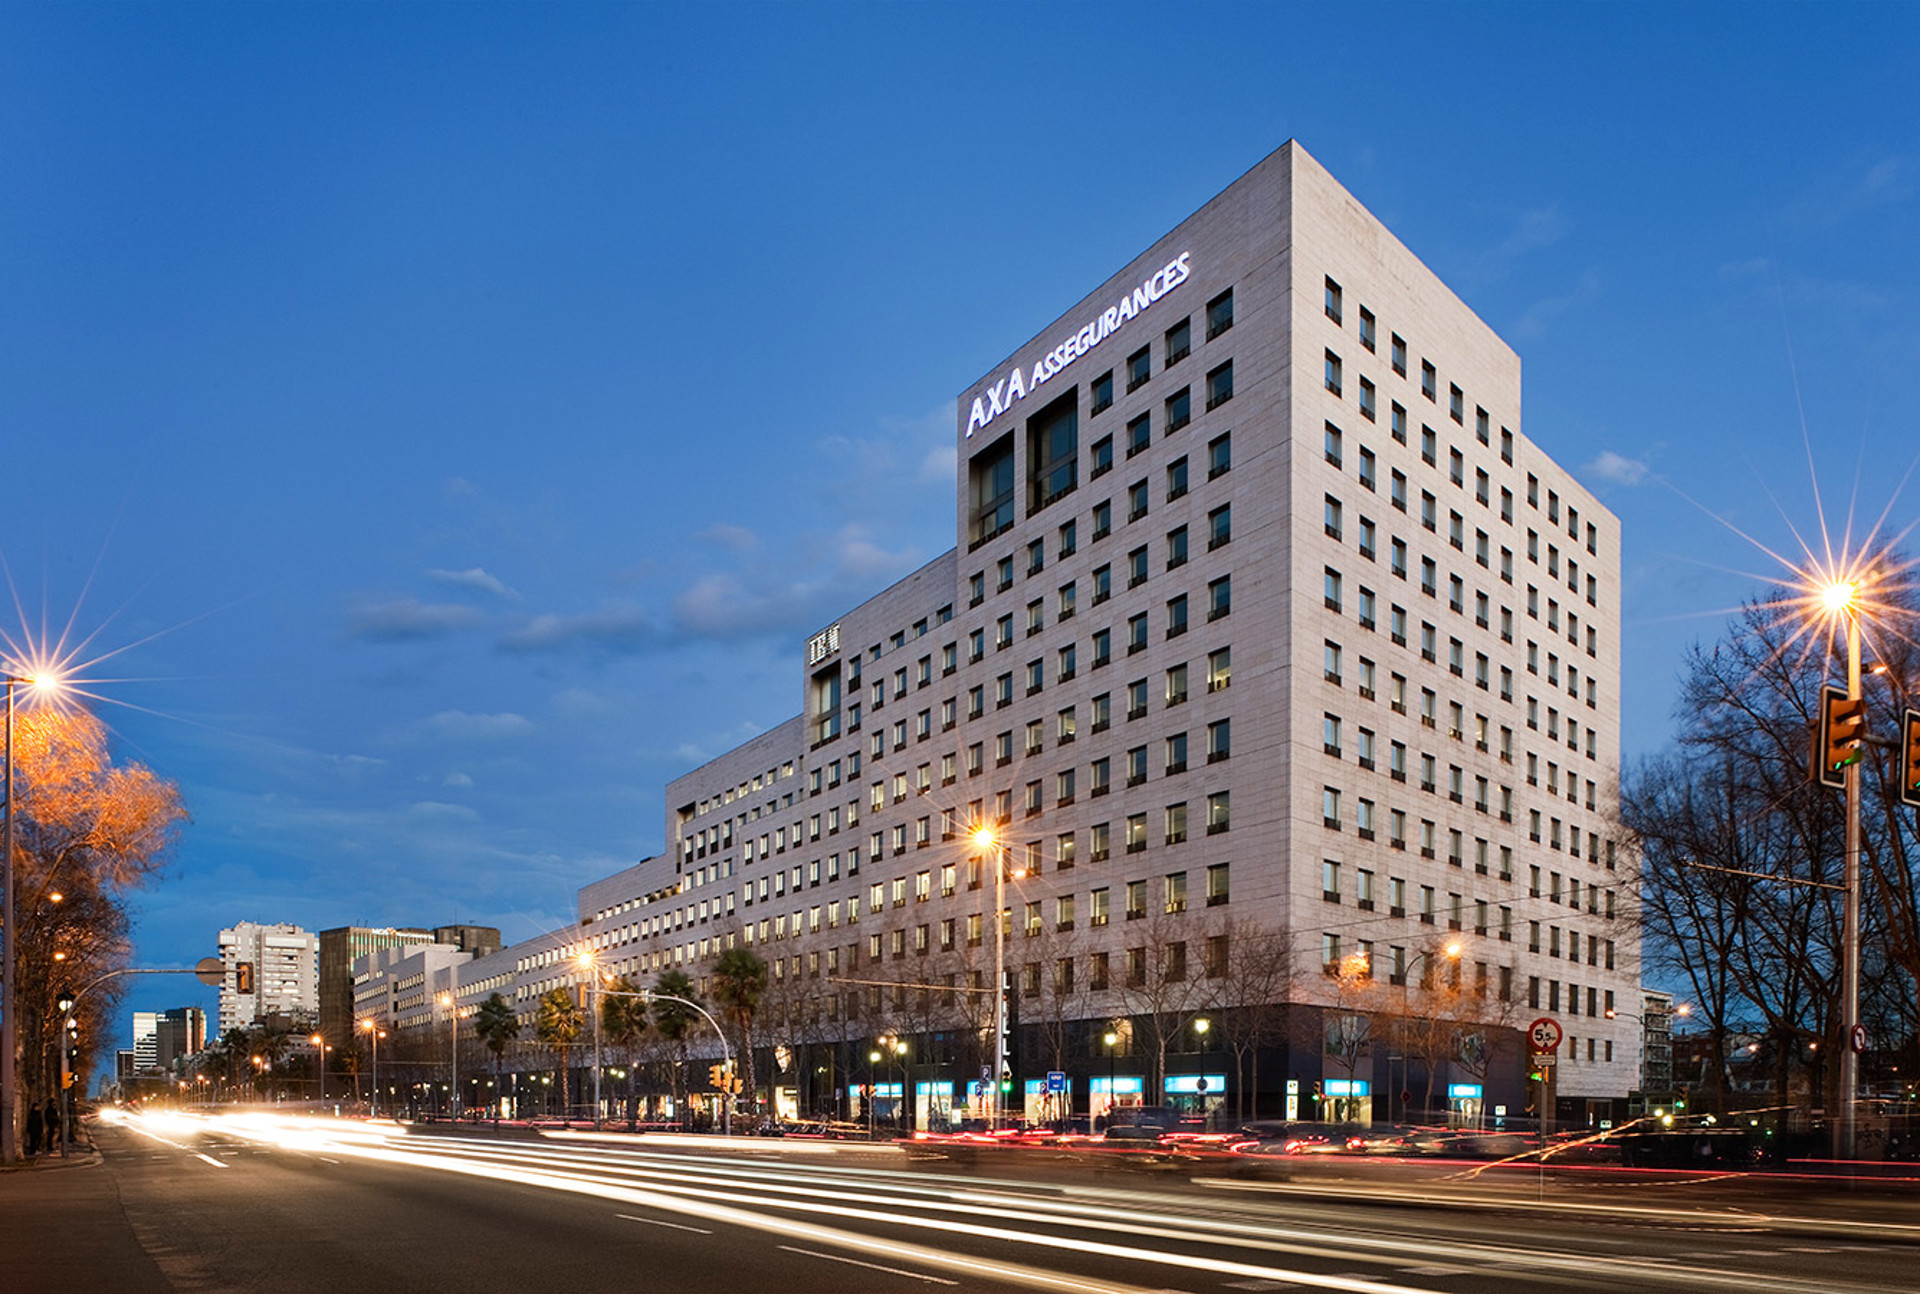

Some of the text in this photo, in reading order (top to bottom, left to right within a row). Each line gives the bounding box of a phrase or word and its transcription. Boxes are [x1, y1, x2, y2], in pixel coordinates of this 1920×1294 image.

[965, 250, 1190, 438] AXA ASSEGURANCES
[809, 624, 840, 666] IBM
